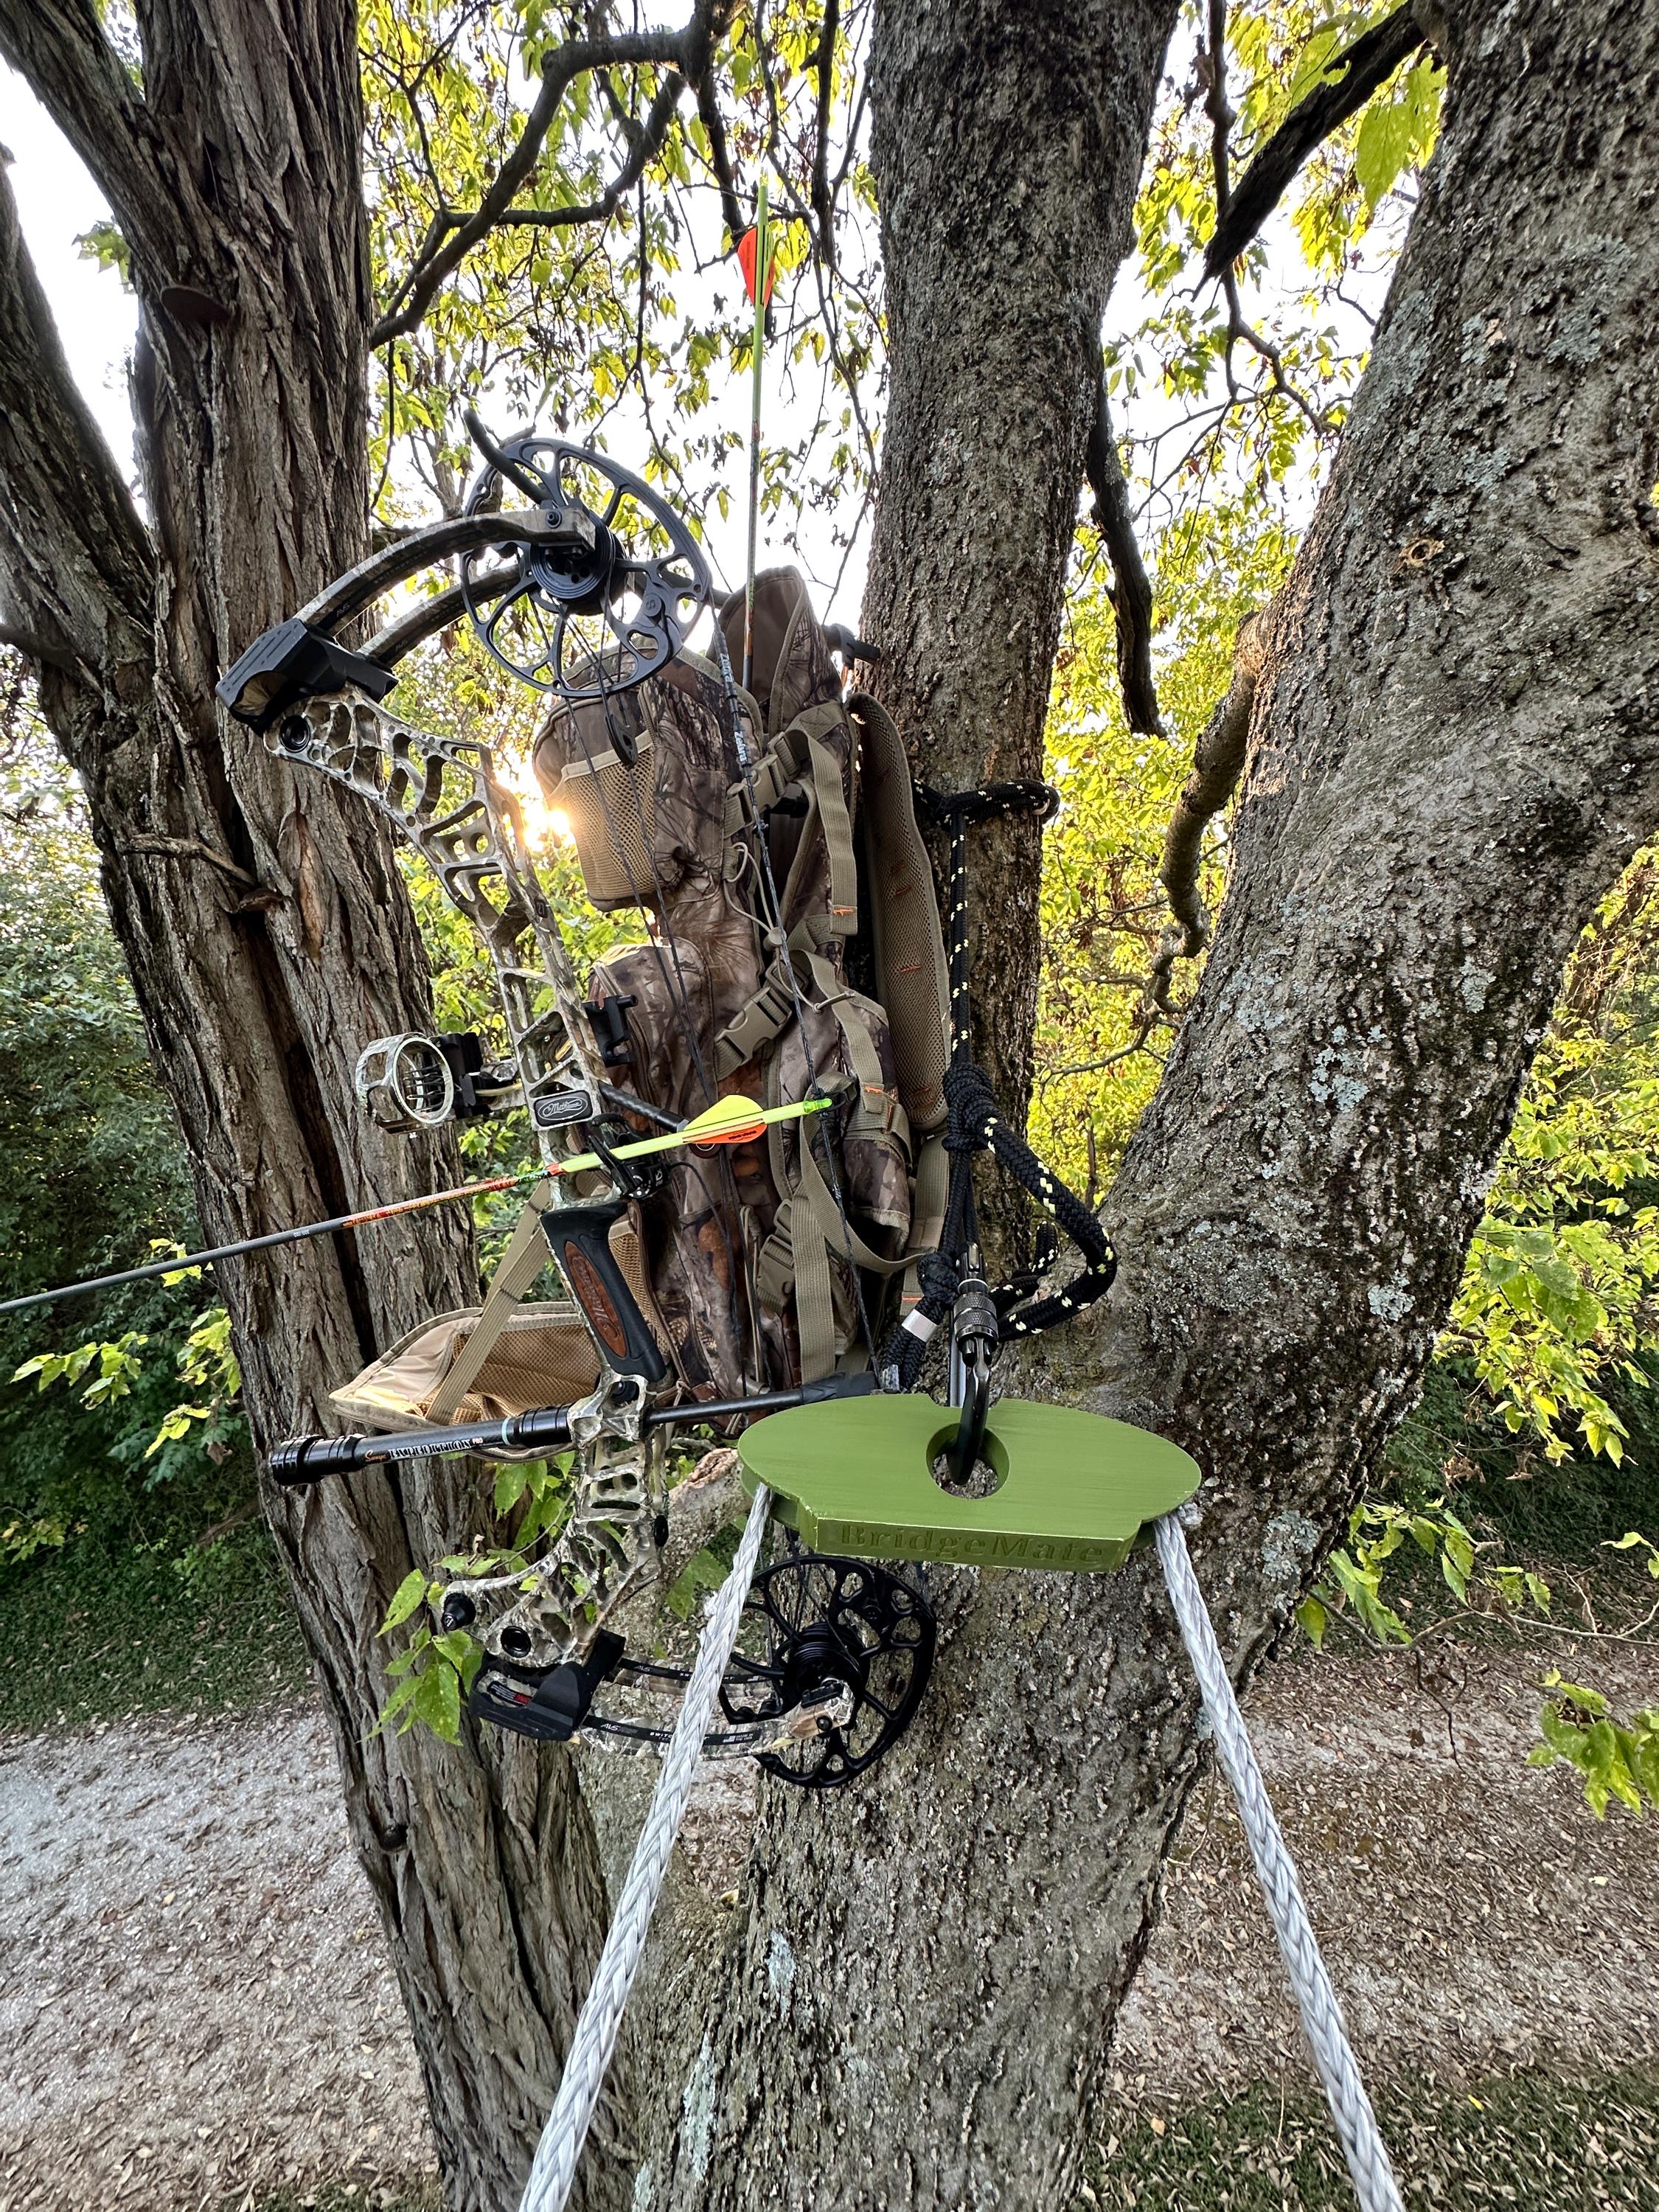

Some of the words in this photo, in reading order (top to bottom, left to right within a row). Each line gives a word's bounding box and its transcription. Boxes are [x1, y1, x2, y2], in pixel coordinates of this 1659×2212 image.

[734, 731, 748, 762] Zebra
[388, 1439, 471, 1459] EXPEDITION
[839, 1525, 1102, 1562] BridgeMate
